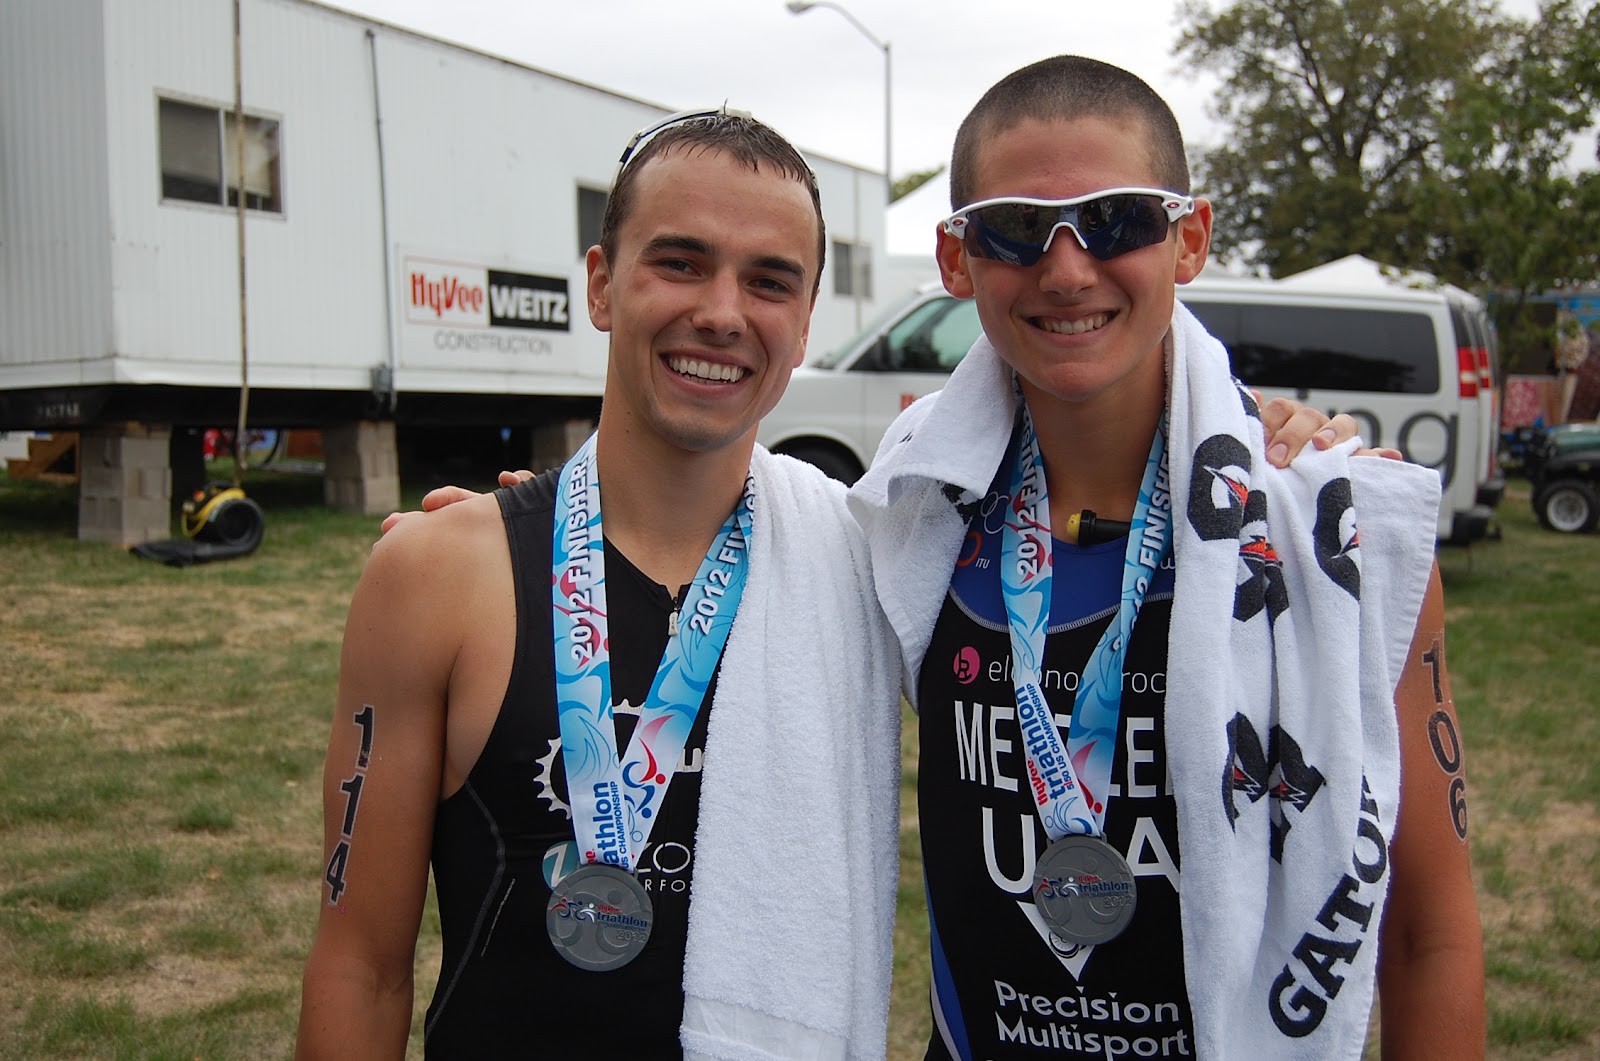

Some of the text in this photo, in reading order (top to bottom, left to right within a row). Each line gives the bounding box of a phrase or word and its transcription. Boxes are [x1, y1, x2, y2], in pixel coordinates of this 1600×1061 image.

[489, 285, 568, 324] WEITZ
[434, 330, 552, 355] CONSTRUCTION
[568, 456, 593, 660] 2012 FINISHER
[975, 557, 990, 568] ITU
[1017, 505, 1037, 575] 2012
[690, 568, 731, 635] 2012
[1015, 686, 1066, 800] triathlon
[1026, 683, 1061, 754] CHAMPIONSHIP
[1422, 636, 1468, 842] 106
[1055, 755, 1067, 769] US
[592, 782, 620, 865] athlon
[609, 781, 627, 854] CHAMPIONSHIP
[982, 806, 1181, 894] UA
[1079, 881, 1129, 893] triathlon
[1103, 895, 1133, 908] 2012
[1268, 766, 1388, 1038] GATO
[597, 911, 648, 928] triathlon
[616, 929, 648, 943] 2012
[994, 979, 1180, 1024] Precision
[994, 1011, 1190, 1061] Multisport
